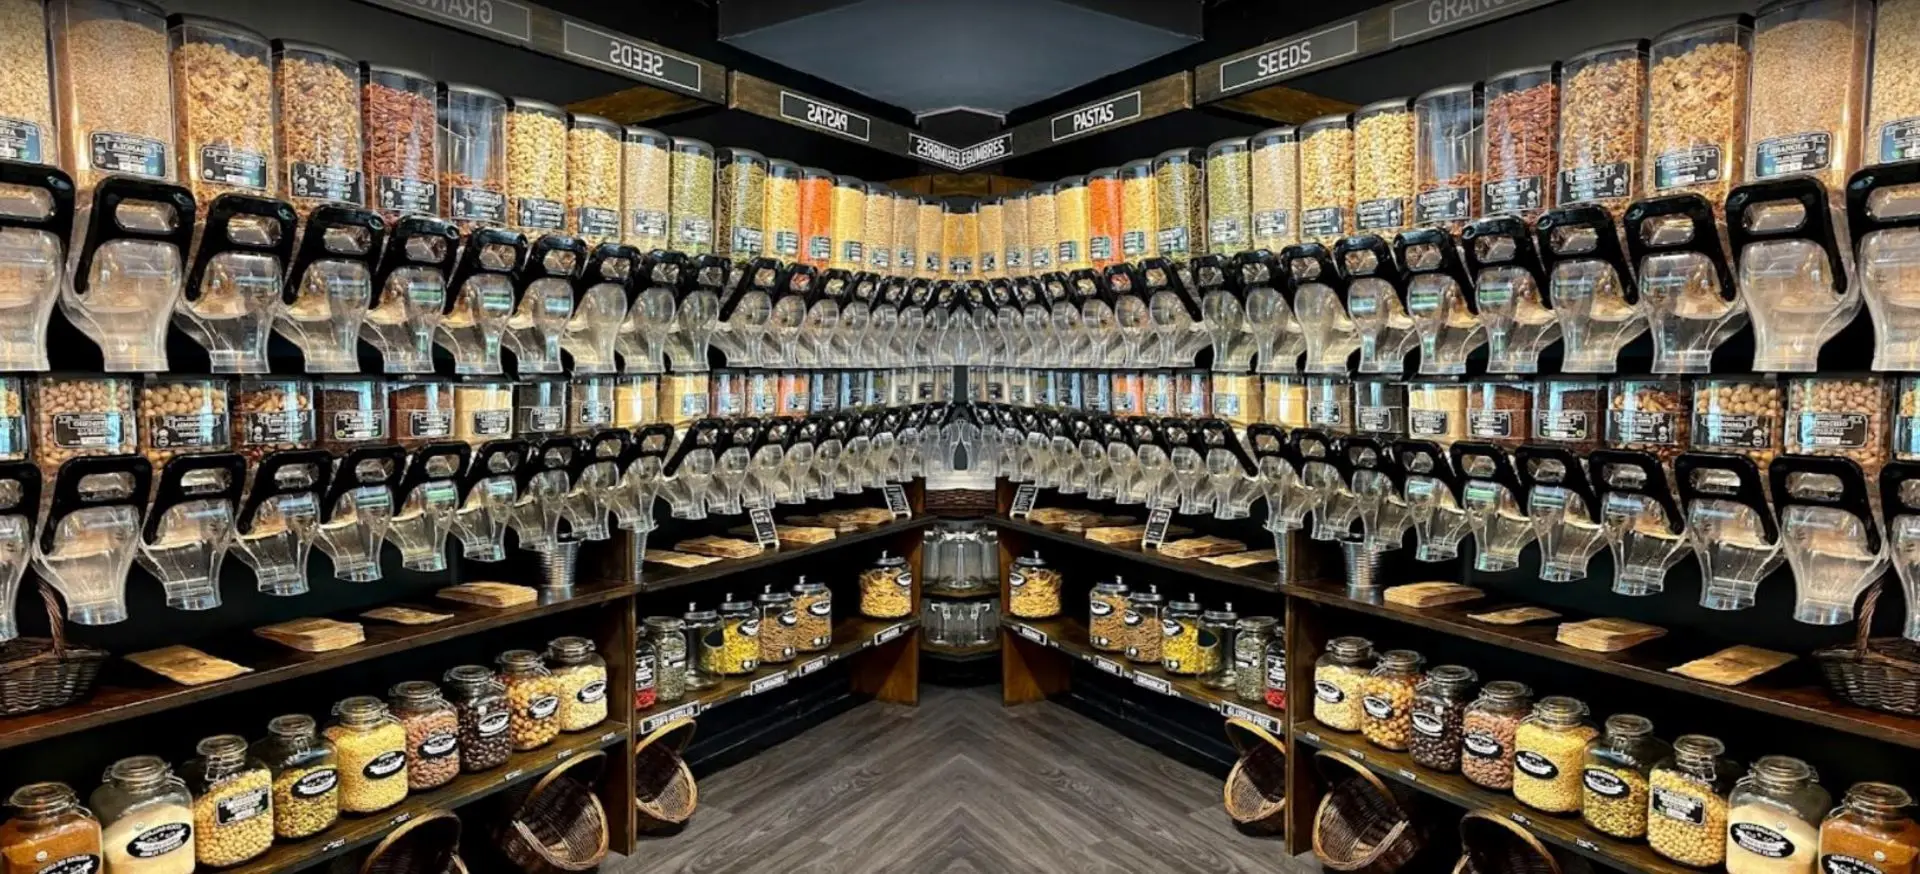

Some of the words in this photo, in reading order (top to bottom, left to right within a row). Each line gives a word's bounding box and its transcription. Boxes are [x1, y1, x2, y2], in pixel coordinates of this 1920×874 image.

[1256, 41, 1312, 77] SEEDS
[1073, 103, 1114, 130] PASTAS
[961, 138, 1005, 167] EGUMBRES
